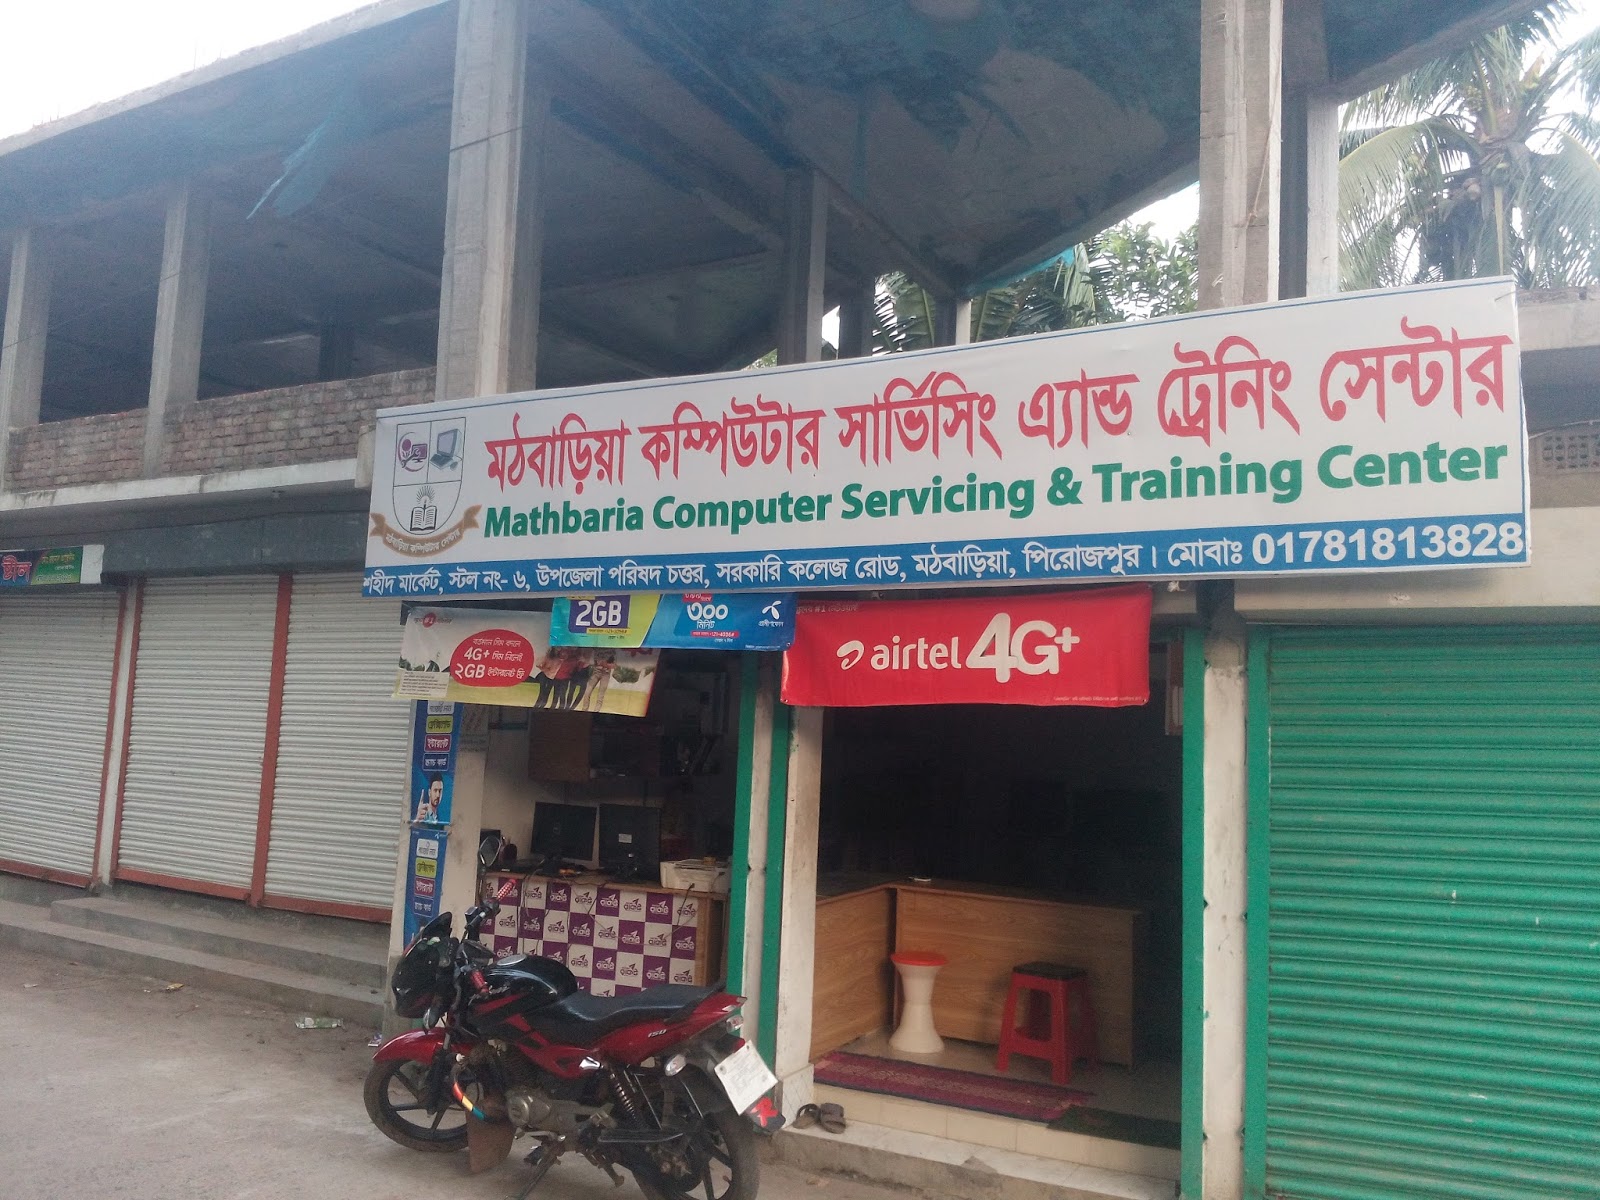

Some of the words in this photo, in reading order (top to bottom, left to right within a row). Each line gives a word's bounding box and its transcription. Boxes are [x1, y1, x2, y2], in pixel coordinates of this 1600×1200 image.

[484, 412, 632, 495] মঠবাড়িয়া
[638, 394, 827, 481] কম্পিউটার
[834, 370, 1002, 468] সার্ভিসিং
[1157, 335, 1300, 448] ট্রেনিং
[1319, 315, 1514, 423] সেন্টার
[484, 497, 644, 538] Mathbaria
[652, 491, 832, 535] Computer
[841, 472, 1034, 520] Servicing
[1046, 466, 1083, 506] &
[1092, 451, 1302, 504] Training
[1317, 441, 1508, 490] Center
[363, 568, 396, 596] শহীদ
[398, 566, 444, 596] মার্কেট,
[448, 567, 481, 592] স্টল
[536, 563, 602, 590] উপজেলা
[608, 559, 664, 587] পরিষদ
[715, 554, 784, 584] সরকারি
[786, 557, 851, 581] কলেজ
[855, 554, 907, 583] রোড,
[911, 544, 1016, 579] মঠবাড়িয়া,
[1023, 541, 1144, 575] পিরোজপুর
[1252, 521, 1524, 566] 01781813828
[575, 600, 622, 627] 2GB
[687, 602, 729, 621] ৩০০
[464, 646, 490, 661] 4G+
[870, 635, 962, 671] airtel
[966, 612, 1080, 683] 4G+
